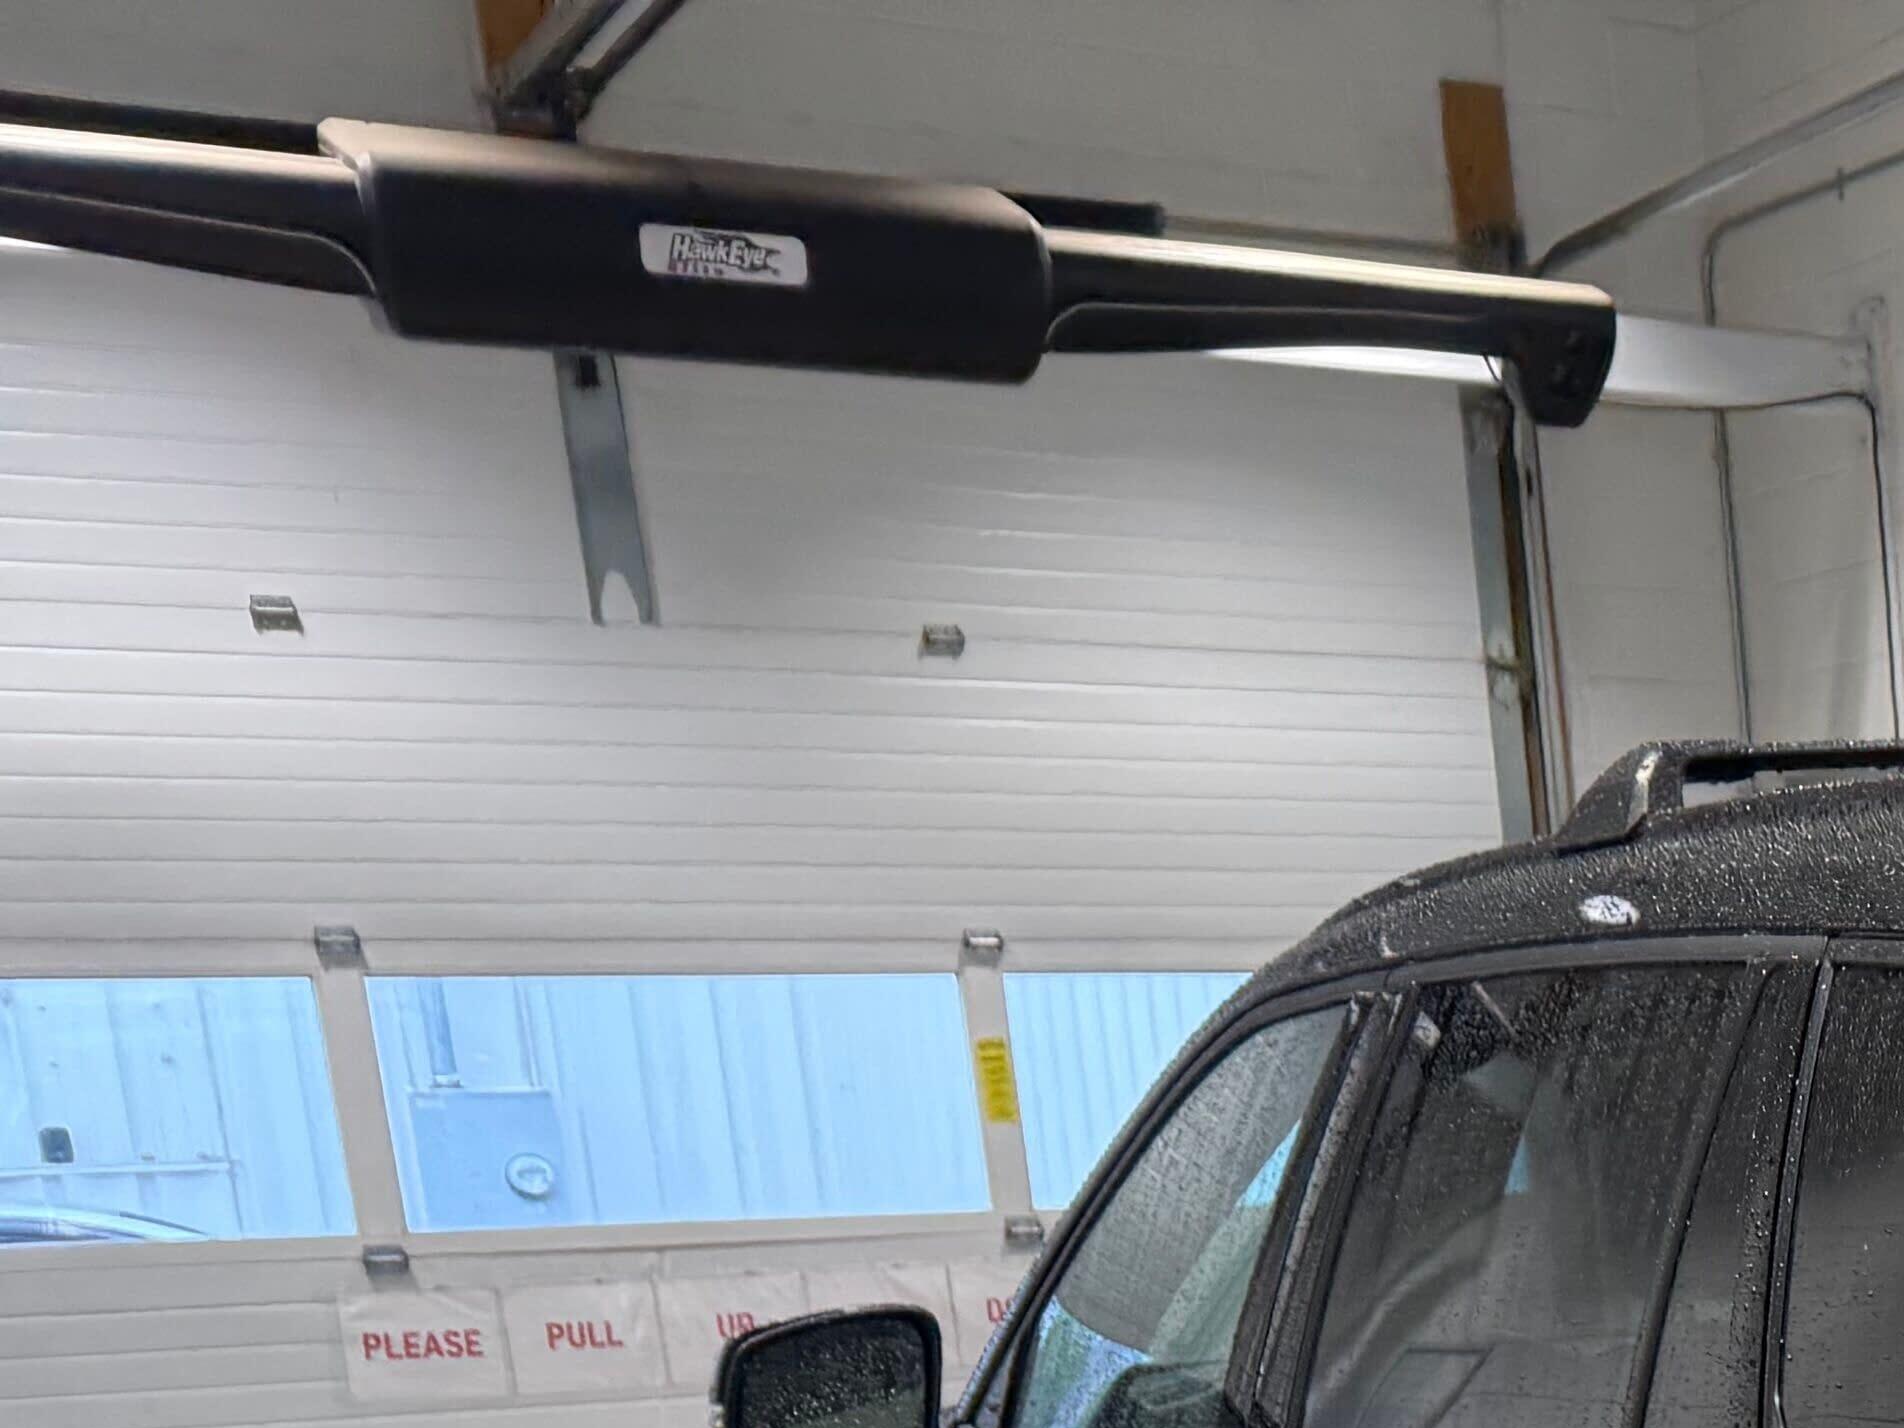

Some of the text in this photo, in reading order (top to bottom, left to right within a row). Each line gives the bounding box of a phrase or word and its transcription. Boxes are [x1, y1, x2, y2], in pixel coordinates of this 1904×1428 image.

[671, 232, 768, 271] HawkEye
[362, 1328, 485, 1361] PLEASE
[545, 1319, 625, 1351] PULL
